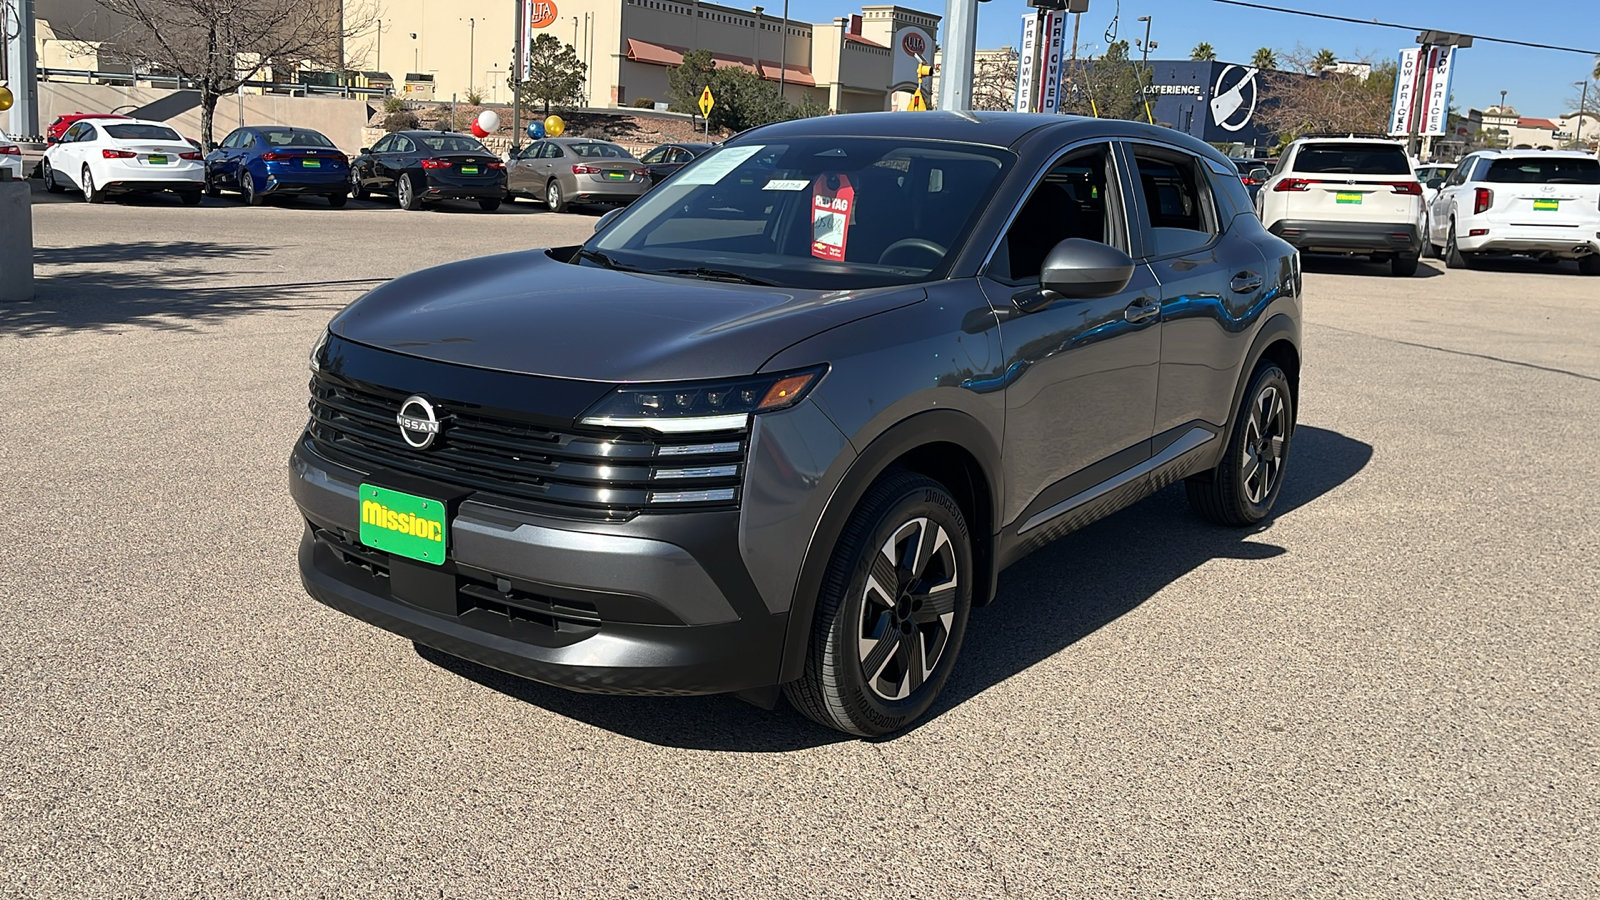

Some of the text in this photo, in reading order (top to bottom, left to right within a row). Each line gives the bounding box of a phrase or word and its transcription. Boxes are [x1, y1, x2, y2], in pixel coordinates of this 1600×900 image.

[531, 2, 552, 17] LTA
[906, 36, 924, 50] ULTA
[1019, 19, 1034, 109] PRE OWNED
[1046, 17, 1062, 108] PRE OWNED
[1395, 53, 1413, 132] LOW PRICES
[1429, 50, 1448, 132] LOW PRICES
[815, 195, 848, 212] RED TAG
[396, 415, 438, 432] NISSAN
[924, 489, 968, 541] BRIDGESTONE
